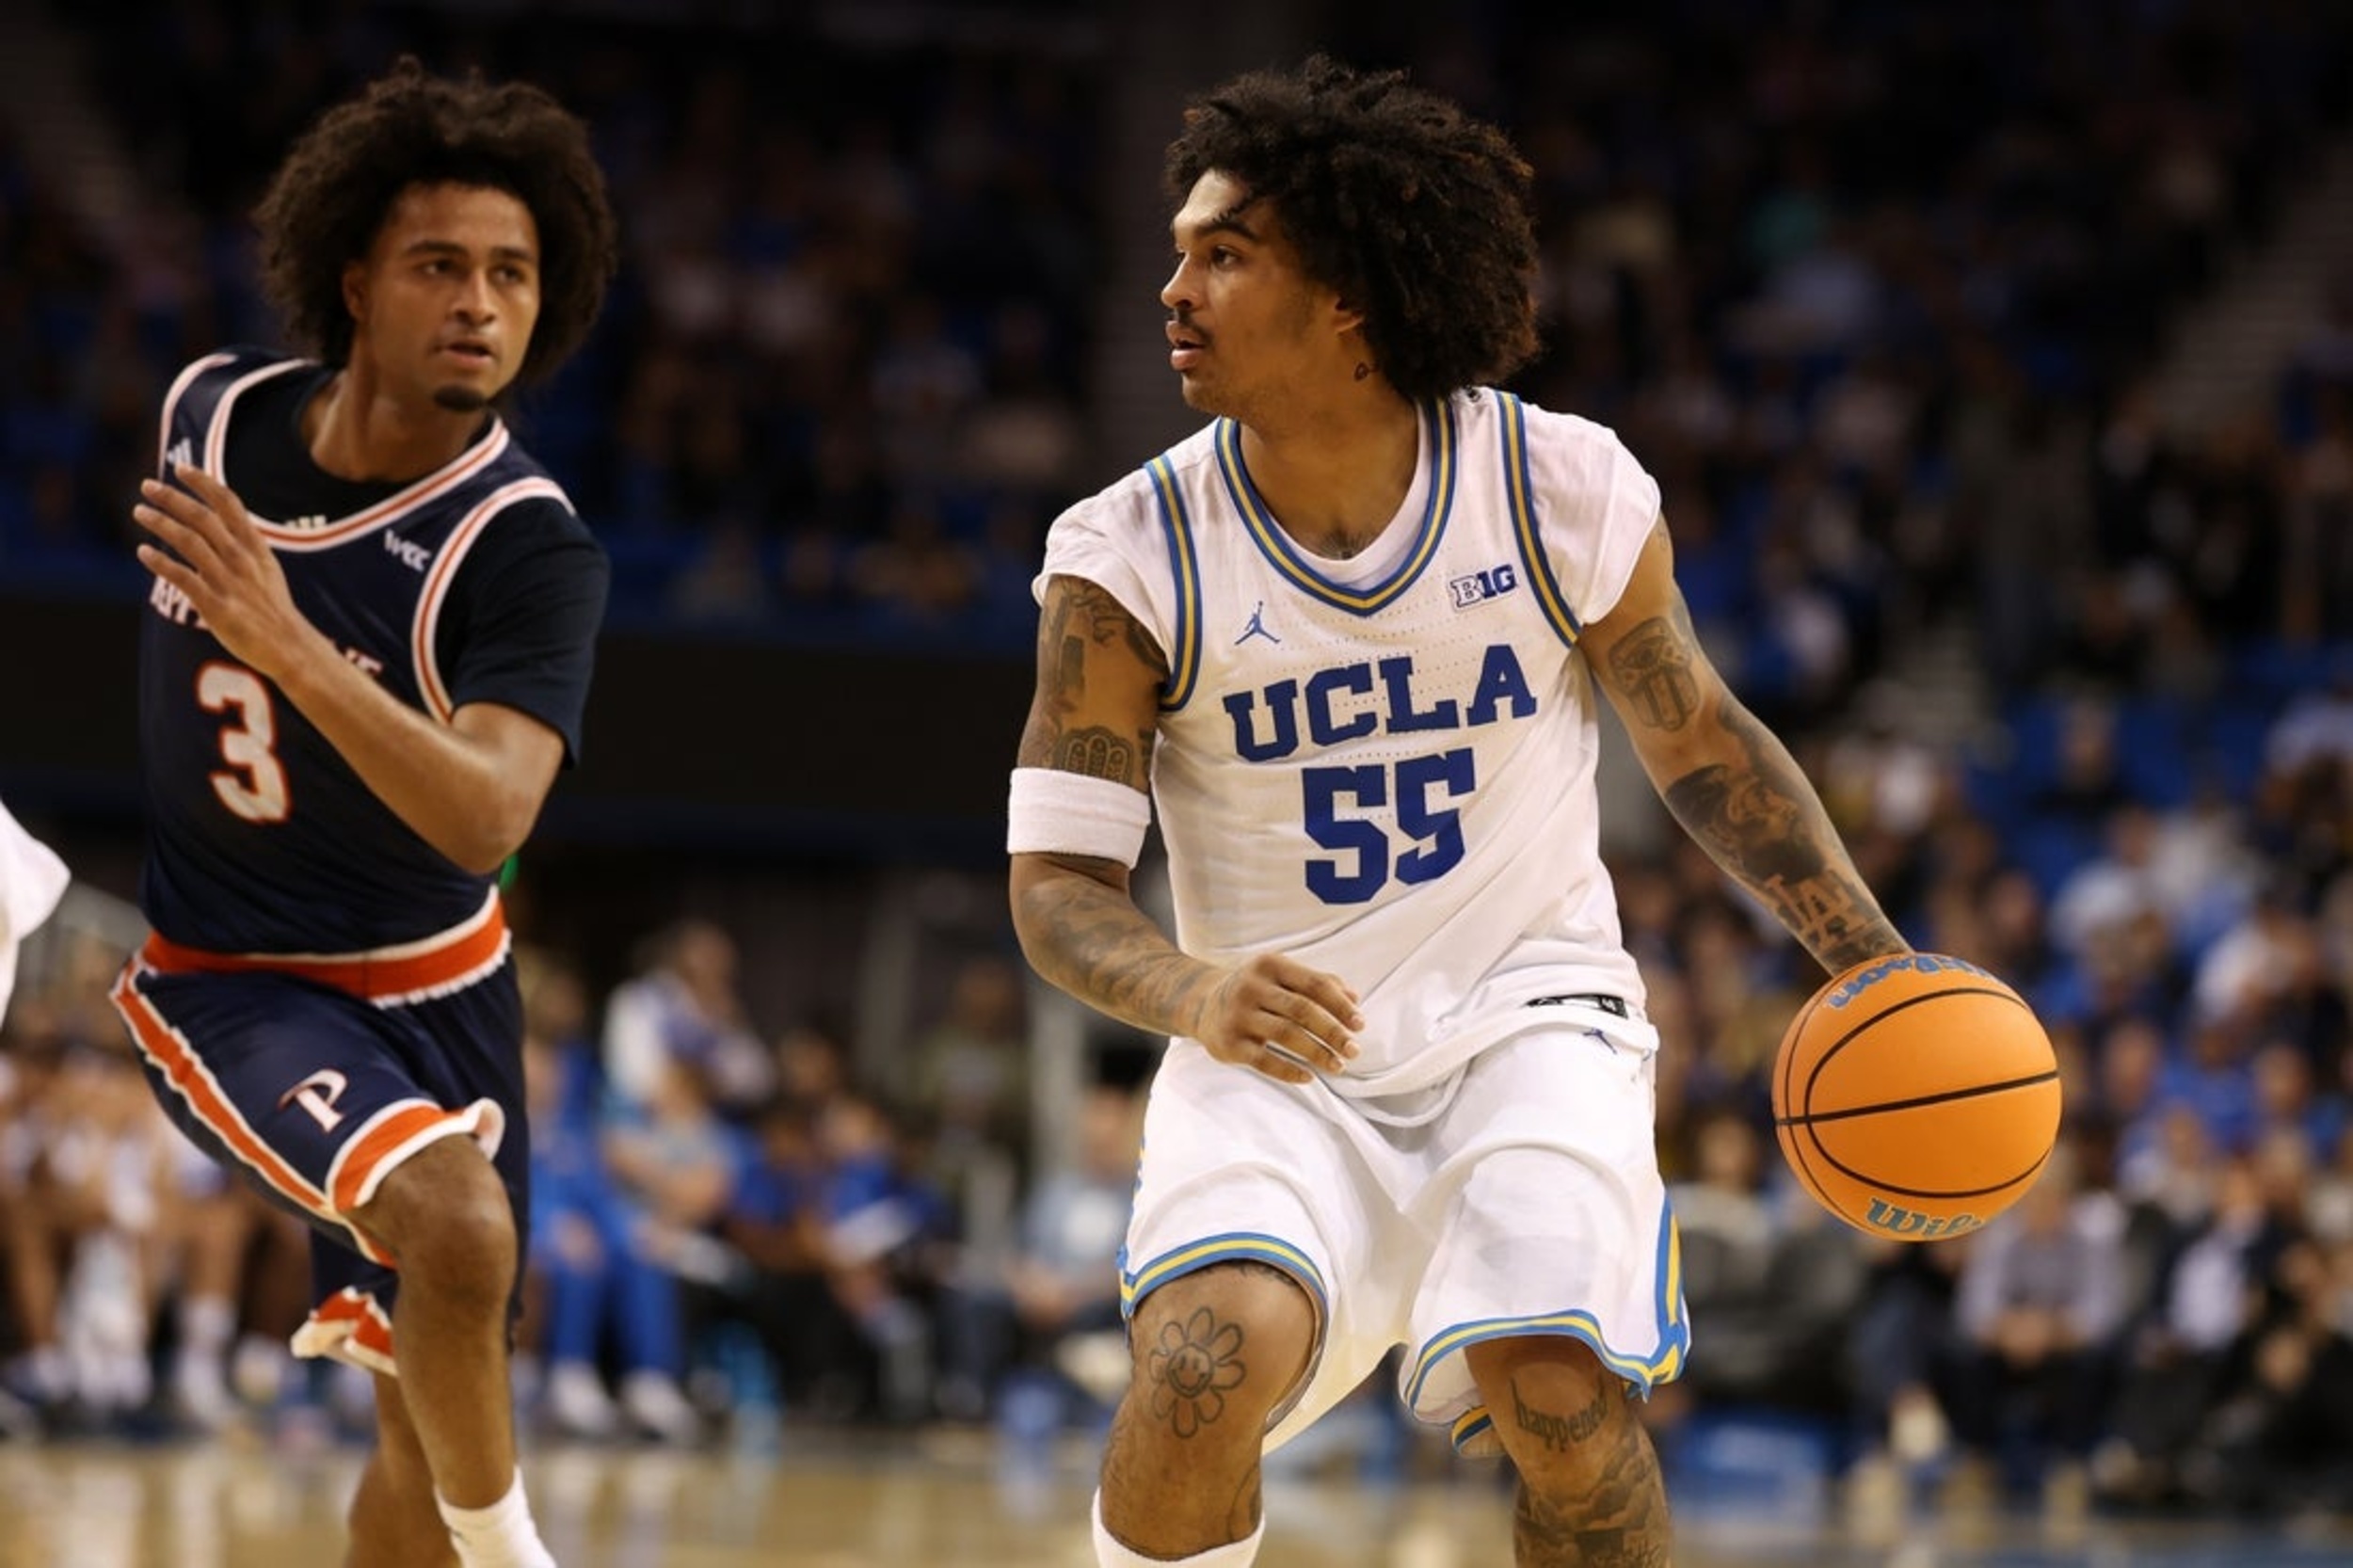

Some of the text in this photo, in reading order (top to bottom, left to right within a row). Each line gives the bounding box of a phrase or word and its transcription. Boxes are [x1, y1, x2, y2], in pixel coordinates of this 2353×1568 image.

[196, 660, 291, 825] 3
[1223, 644, 1537, 762] UCLA
[1302, 748, 1477, 904] 55
[278, 1067, 348, 1134] P
